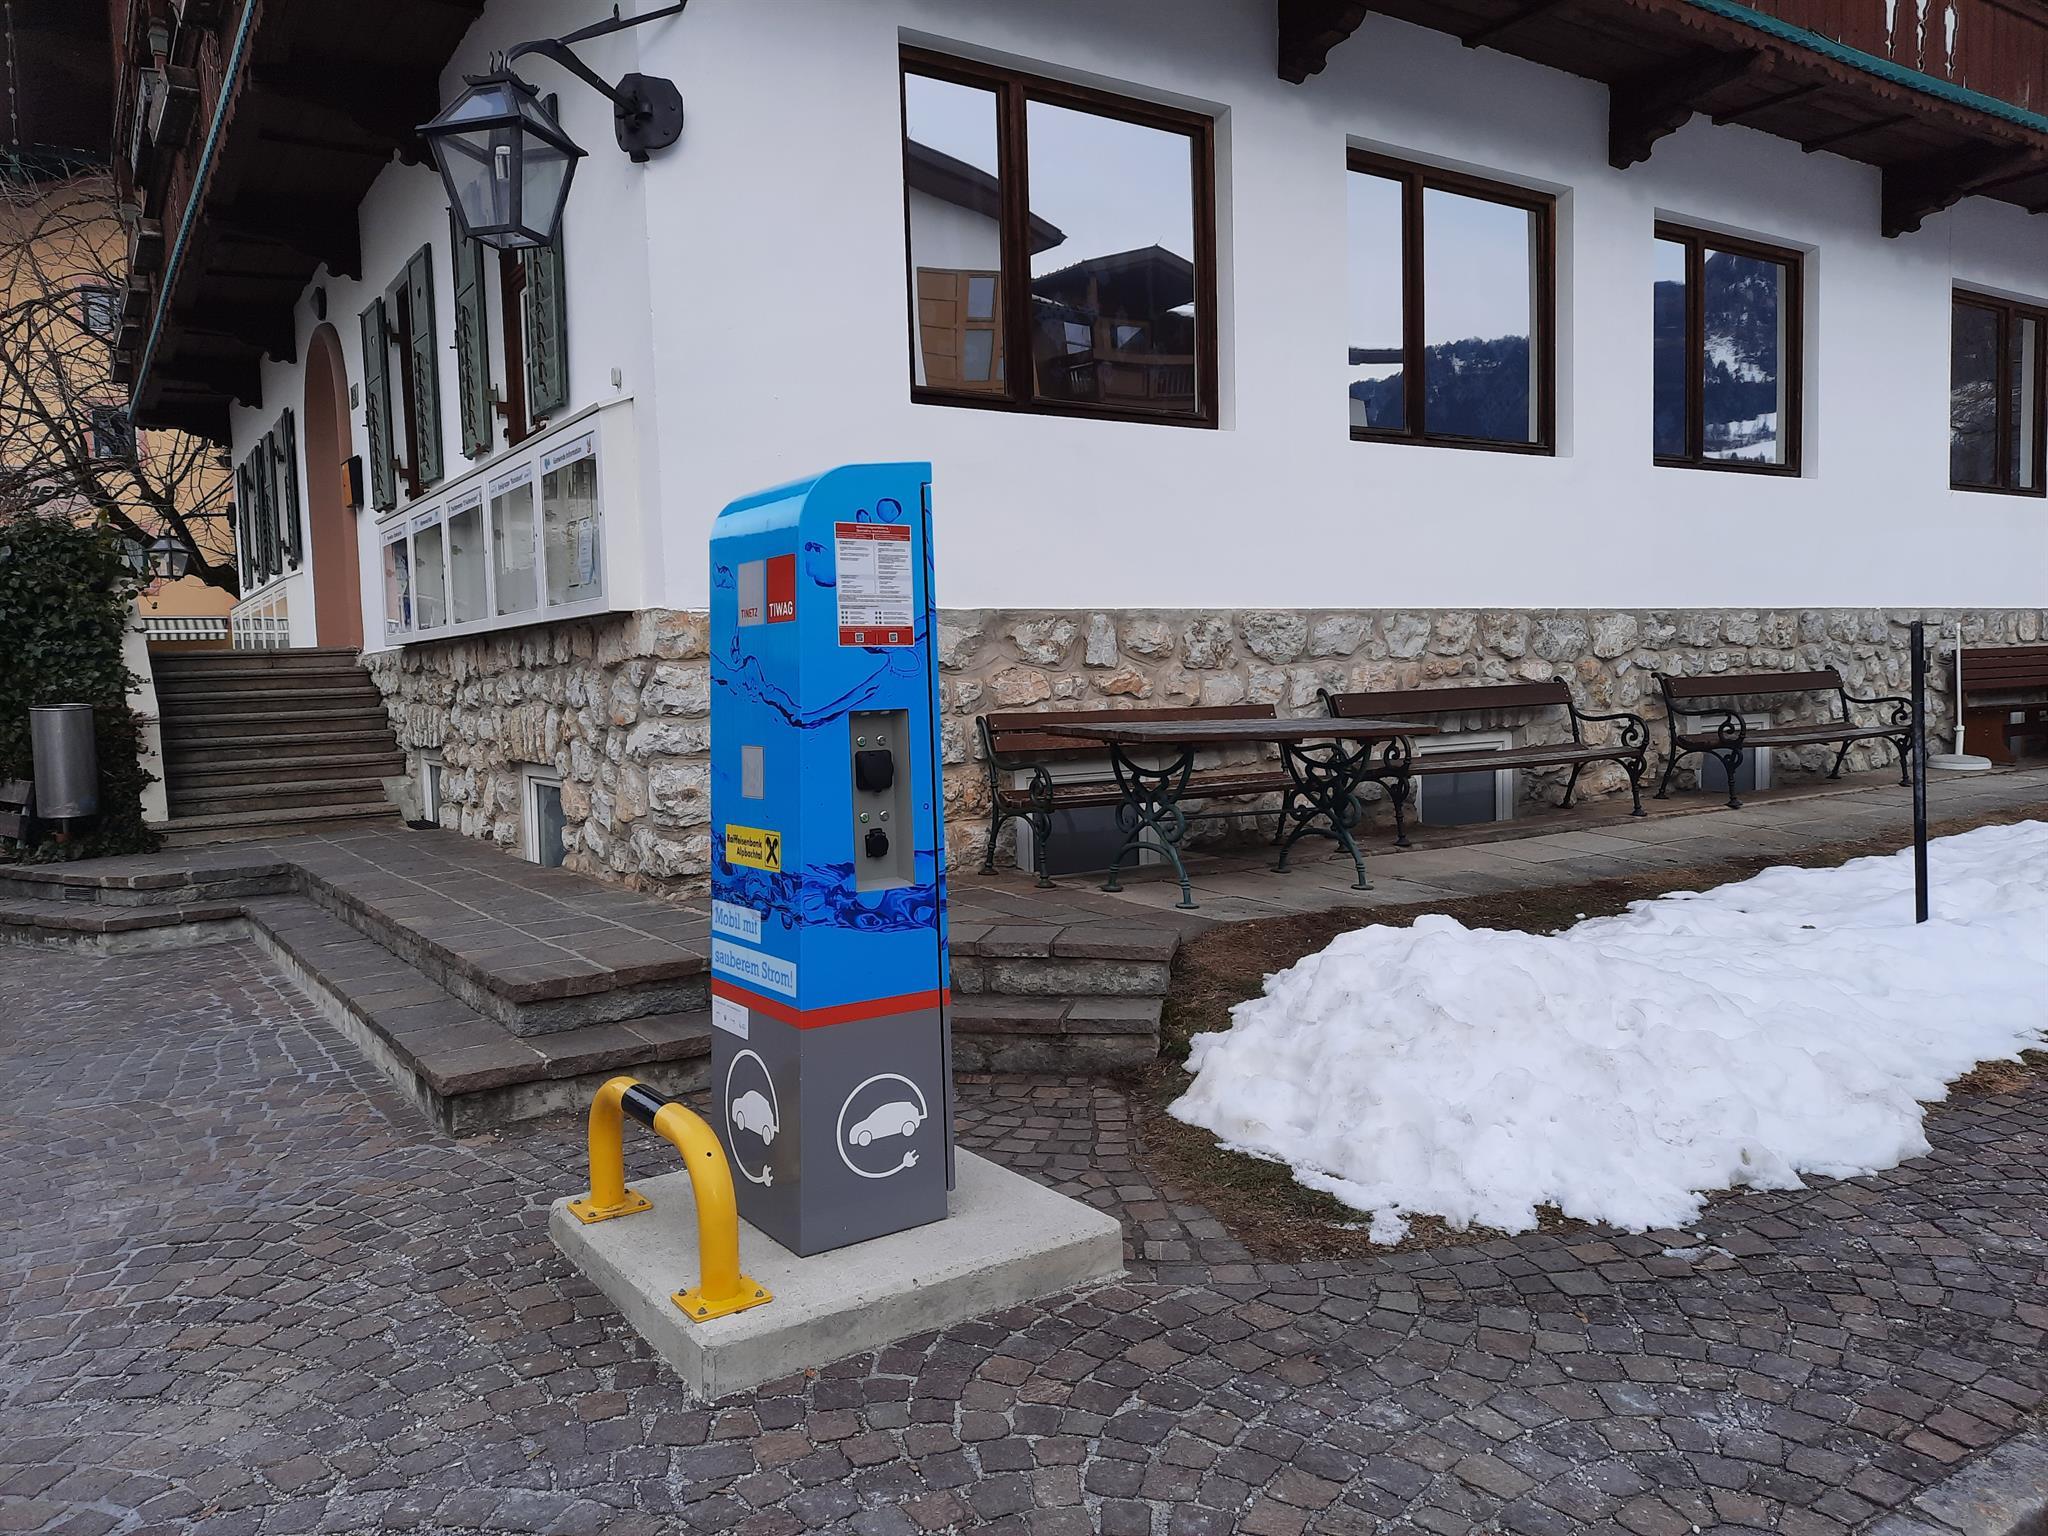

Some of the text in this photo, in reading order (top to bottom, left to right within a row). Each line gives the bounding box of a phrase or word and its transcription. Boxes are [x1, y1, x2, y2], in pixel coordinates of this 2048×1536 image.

[741, 608, 758, 619] TINETZ
[768, 600, 793, 618] TIWAG
[726, 834, 762, 848] Raiffeisenbank
[736, 846, 763, 860] Alpbachtal
[714, 907, 759, 935] Mobil mit
[714, 951, 793, 989] sauberem Strom!
